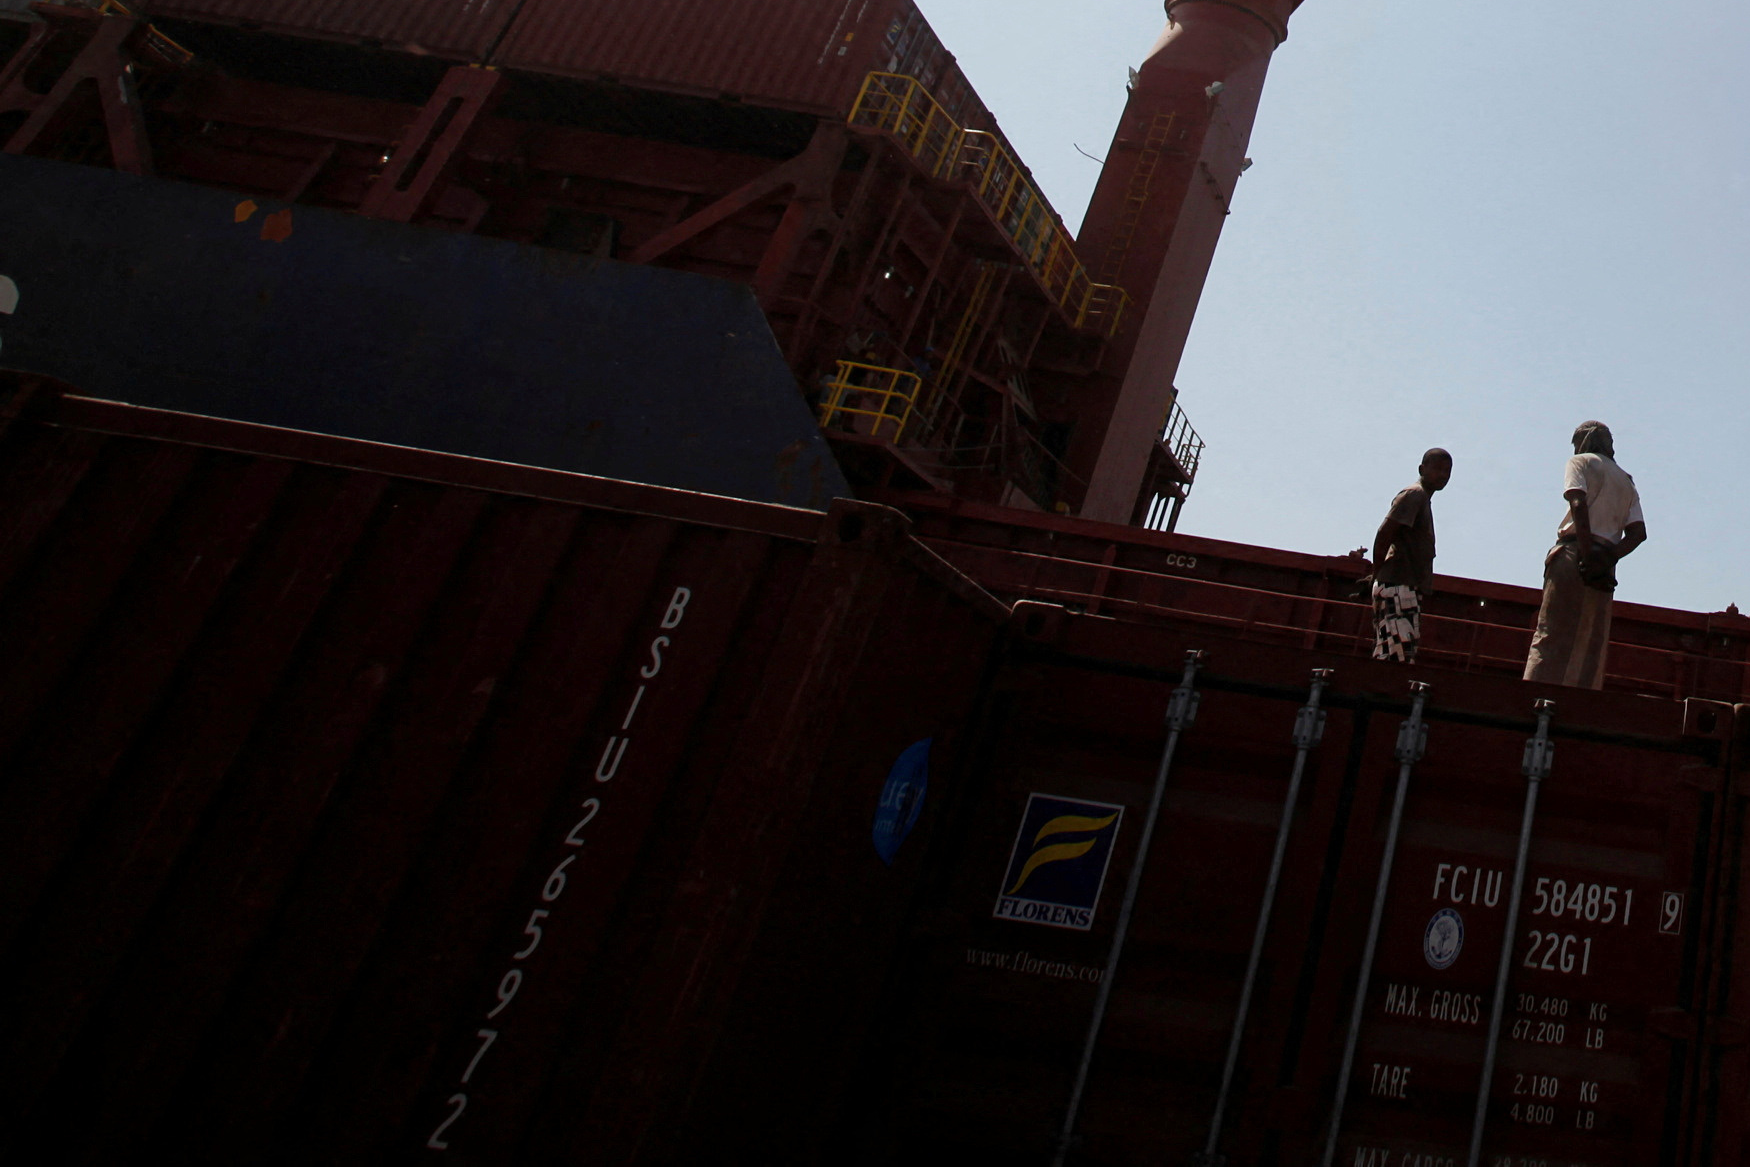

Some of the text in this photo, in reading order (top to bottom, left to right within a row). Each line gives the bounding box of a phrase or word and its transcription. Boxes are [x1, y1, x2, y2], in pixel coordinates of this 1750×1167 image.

[1166, 553, 1197, 569] CC3
[997, 897, 1091, 927] FLORENS
[1432, 862, 1681, 931] FCIU 584851 9
[965, 948, 1106, 983] www.florens.co
[1523, 929, 1593, 976] 22G1
[1430, 989, 1481, 1025] GROSS
[1515, 992, 1569, 1018] 30.480
[1588, 1002, 1608, 1022] KG
[1512, 1019, 1604, 1050] 67.200 LB
[1370, 1062, 1599, 1104] TARE 2.180 KG
[1510, 1102, 1595, 1130] 4.800 LB
